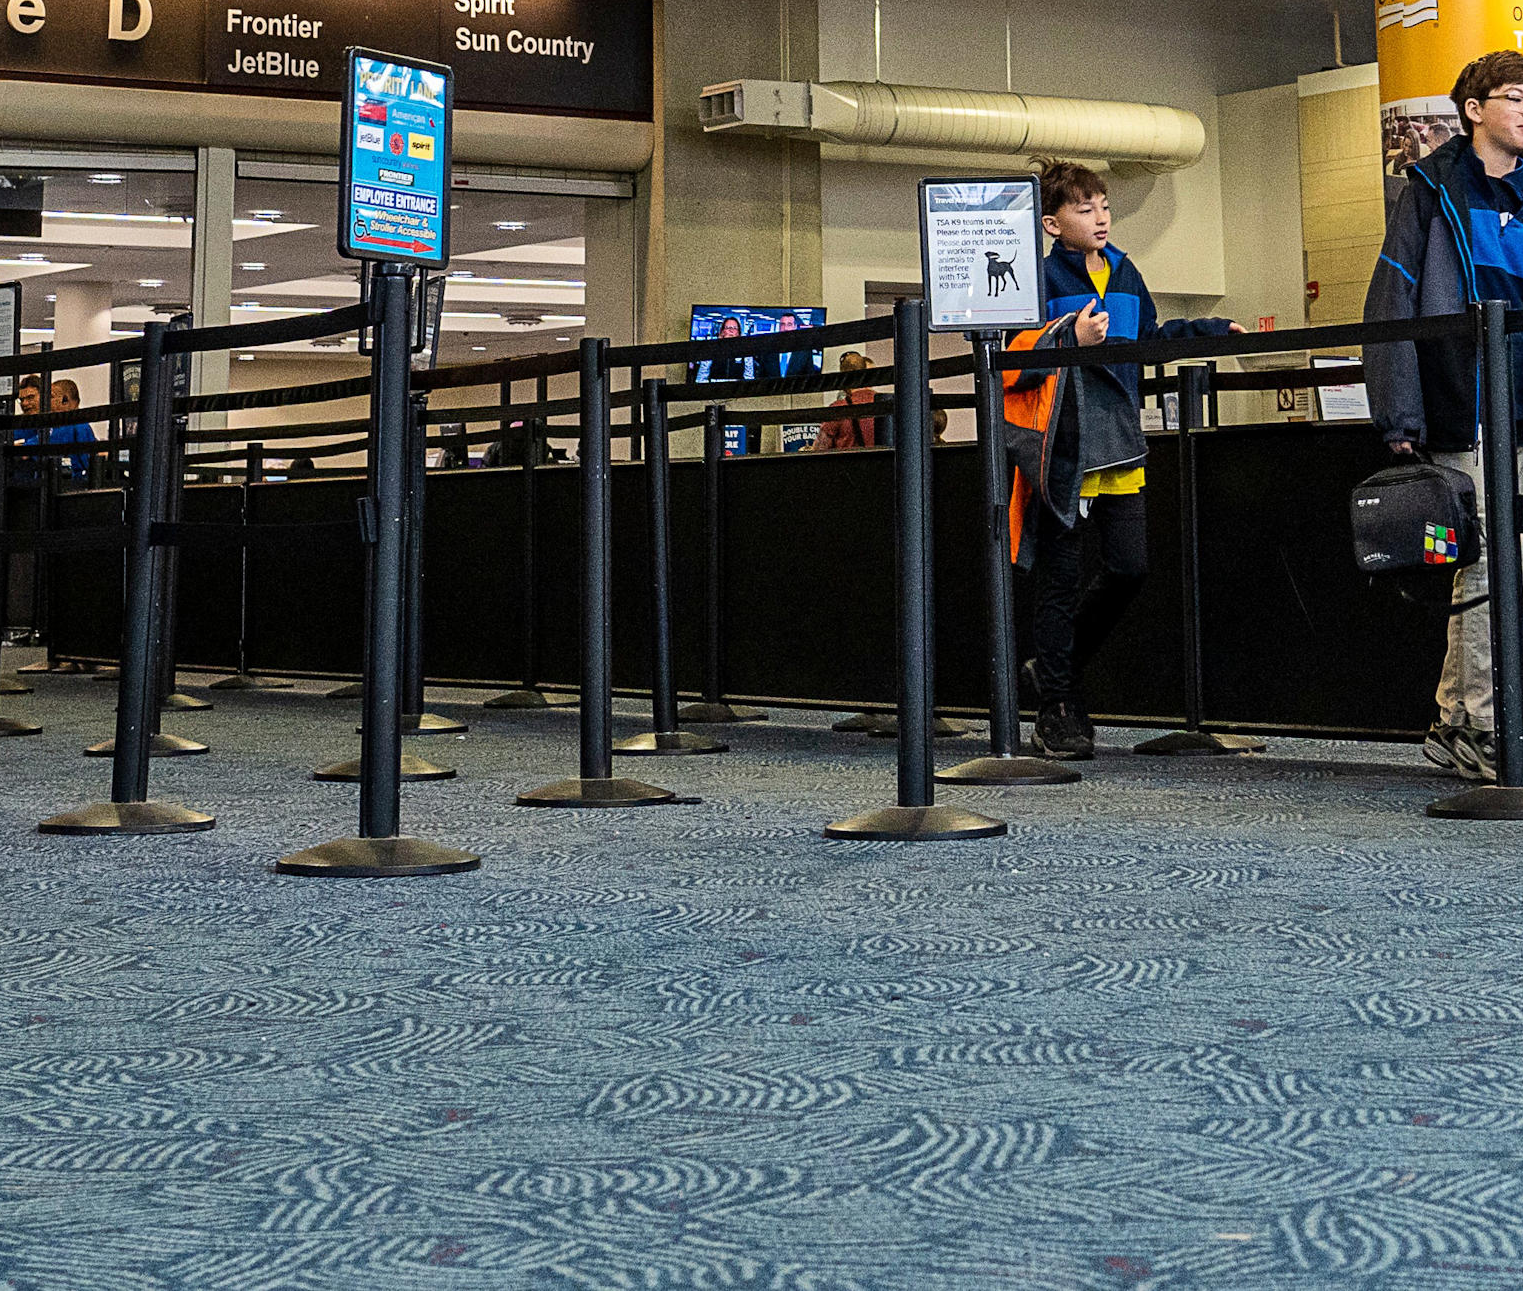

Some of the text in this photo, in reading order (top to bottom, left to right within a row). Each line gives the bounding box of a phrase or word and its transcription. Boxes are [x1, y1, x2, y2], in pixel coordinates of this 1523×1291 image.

[226, 8, 323, 40] Frontier
[455, 26, 594, 65] Sun Country
[227, 49, 320, 79] JetBlue
[412, 141, 431, 151] spirit
[354, 186, 436, 214] EMPLOYEE ENTRANCE
[375, 210, 429, 228] Wheelchair &
[370, 219, 436, 240] Stroller Accessible
[985, 229, 997, 238] pet
[937, 239, 960, 247] Please
[961, 239, 971, 247] do
[1005, 238, 1021, 247] pets
[947, 248, 976, 256] working
[783, 426, 808, 439] DOUBLE
[784, 434, 802, 445] YOUR
